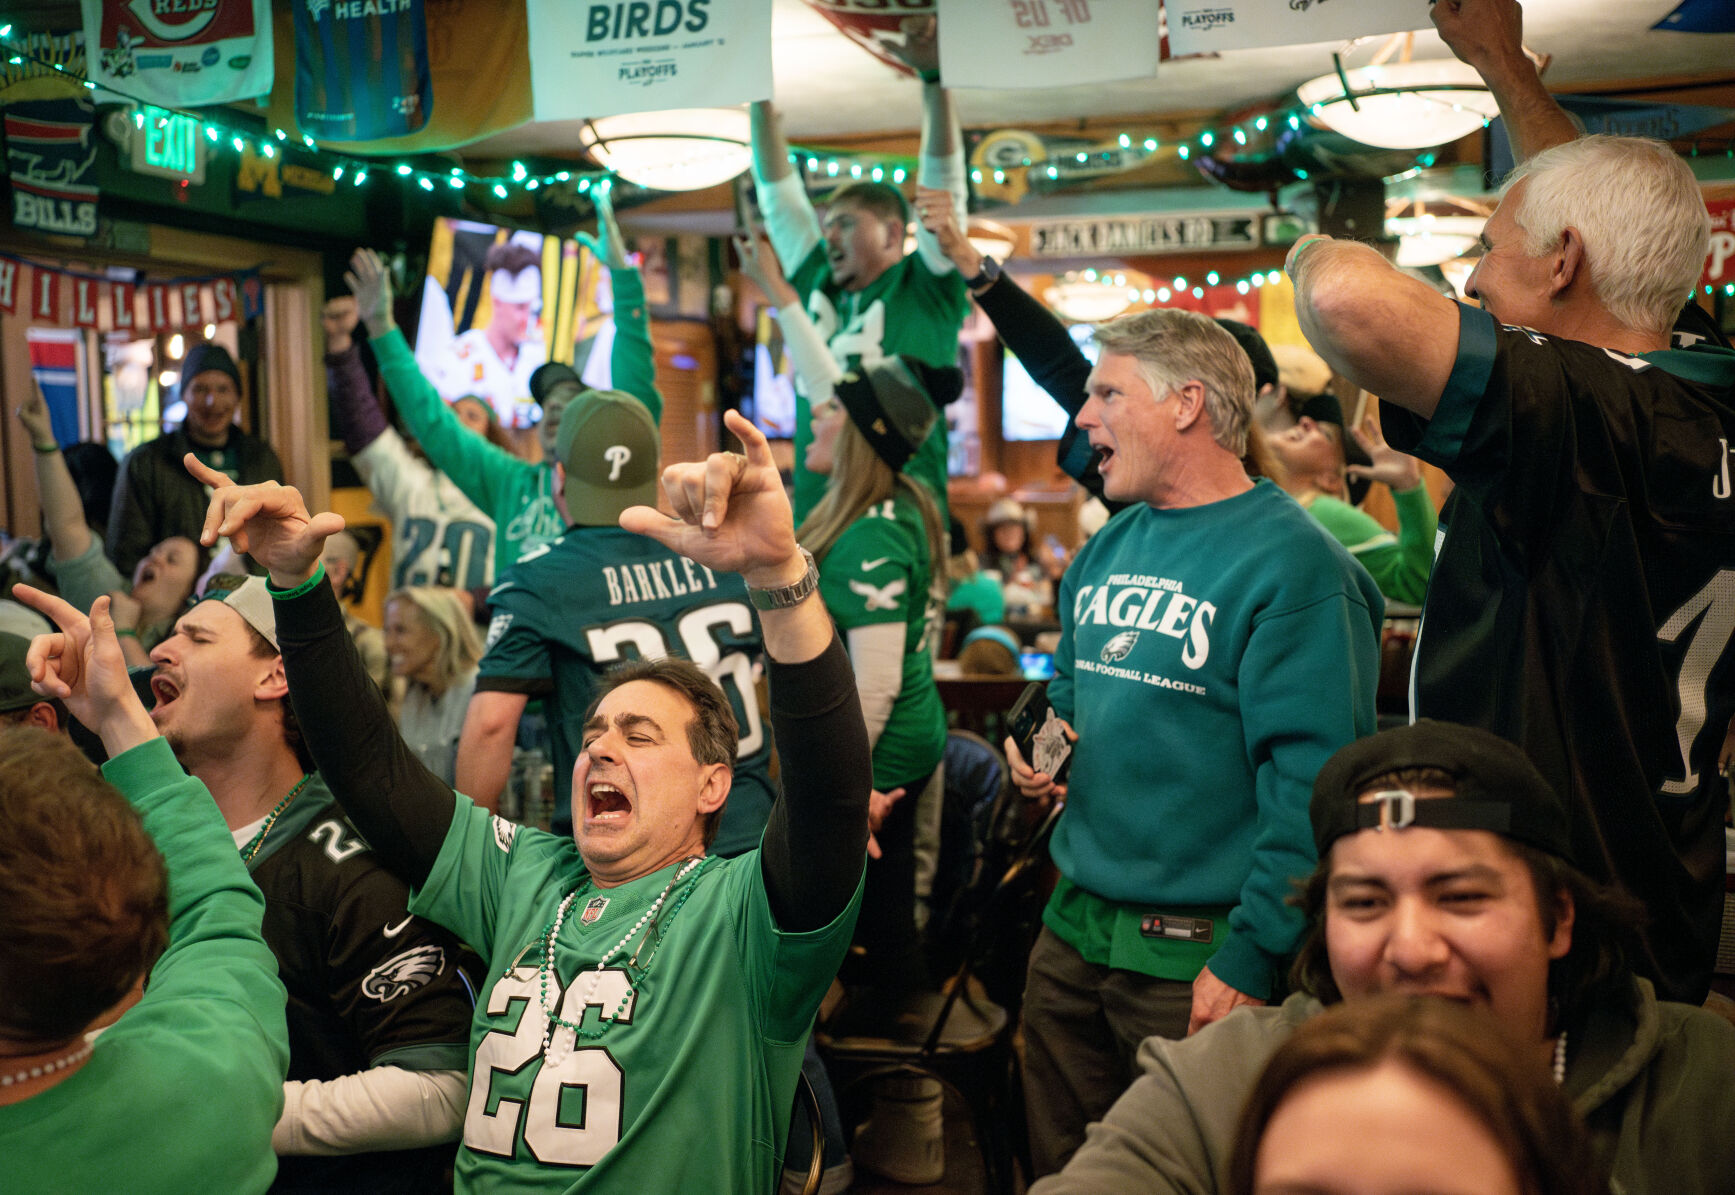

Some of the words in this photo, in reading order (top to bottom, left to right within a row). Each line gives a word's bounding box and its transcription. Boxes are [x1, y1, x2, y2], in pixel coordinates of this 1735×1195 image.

[335, 0, 412, 20] HEALTH
[586, 0, 711, 42] BIRDS
[1182, 12, 1235, 27] PLAYOFFS
[618, 63, 677, 80] PLAYOFFS
[145, 105, 198, 173] EXIT
[15, 191, 97, 236] BILLS
[604, 445, 631, 481] P
[1107, 574, 1183, 593] PHILADELPHIA
[1096, 663, 1141, 681] FOOTBALL
[1143, 673, 1206, 695] LEAGUE
[463, 965, 637, 1167] 26
